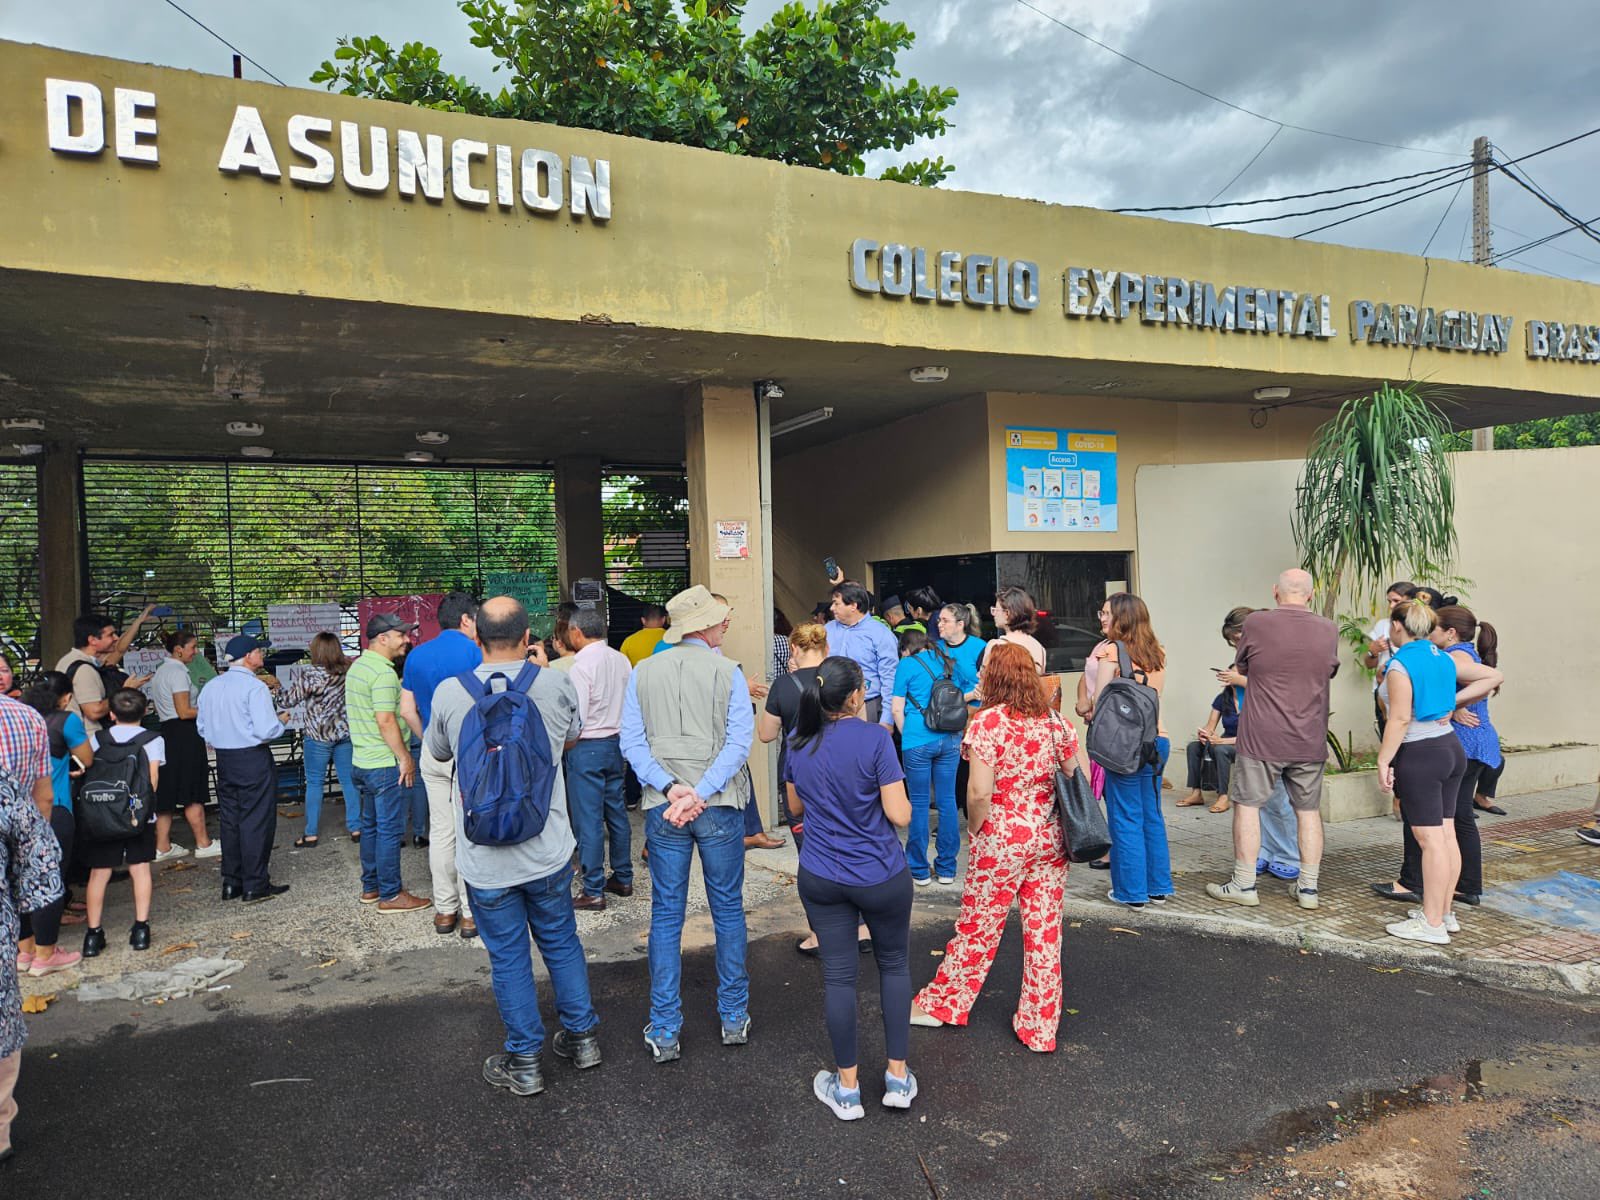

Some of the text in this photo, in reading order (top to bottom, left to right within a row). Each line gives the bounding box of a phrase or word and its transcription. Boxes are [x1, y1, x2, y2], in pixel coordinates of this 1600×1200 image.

[45, 77, 612, 222] DE ASUNCION
[849, 238, 1600, 362] COLEGIO EXPERIMENTAL PARAGUAY BRAS
